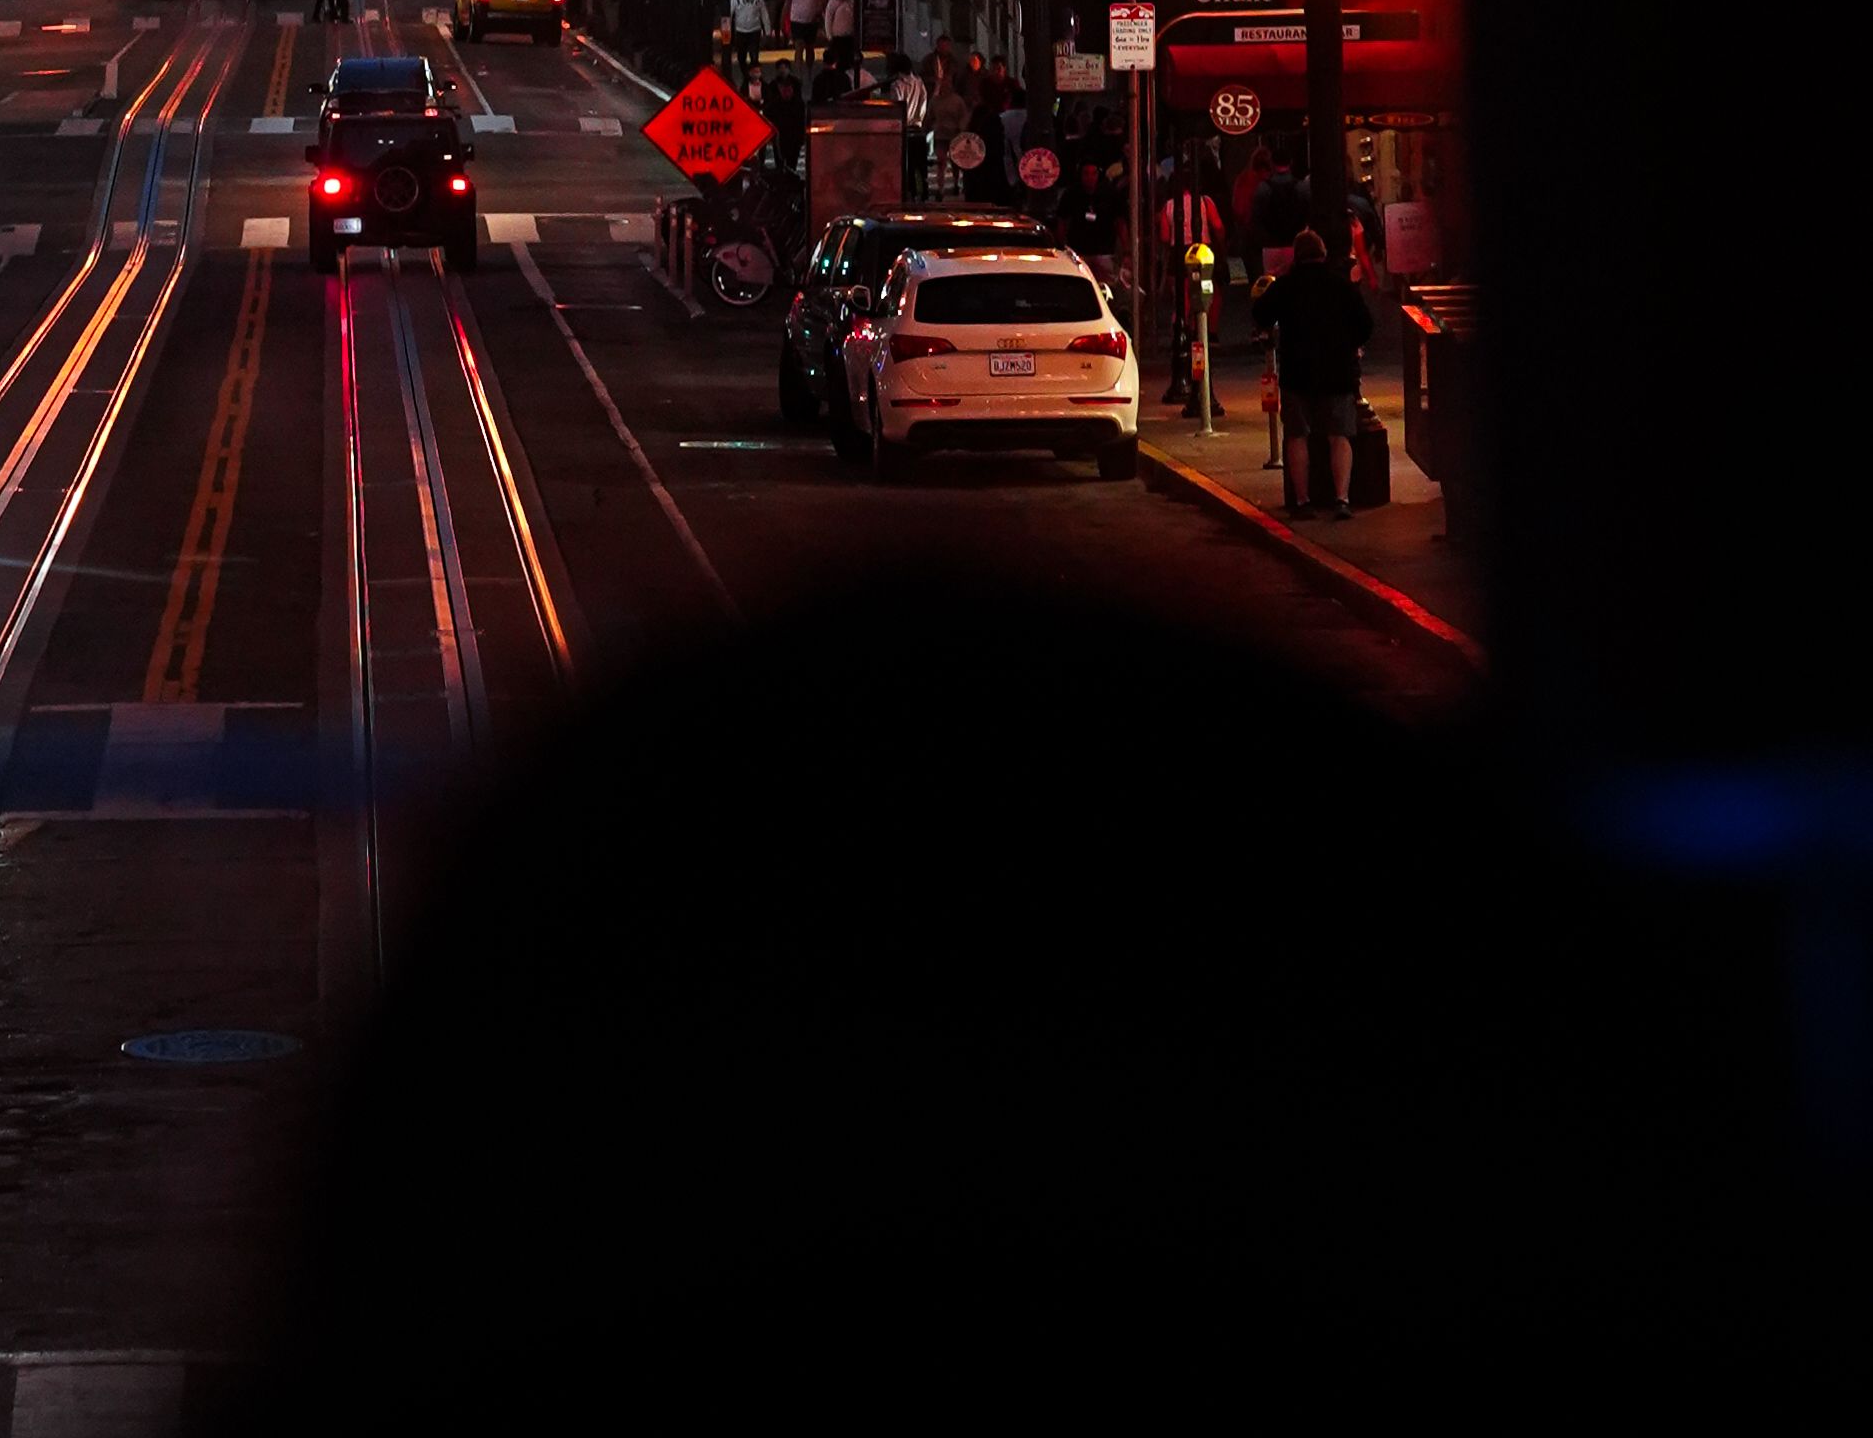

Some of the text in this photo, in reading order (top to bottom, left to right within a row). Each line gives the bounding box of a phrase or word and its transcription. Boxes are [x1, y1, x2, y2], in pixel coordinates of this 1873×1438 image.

[682, 96, 734, 112] ROAD
[1216, 94, 1255, 119] 85
[681, 120, 734, 136] WORK
[1218, 116, 1253, 127] YEARS
[677, 143, 740, 163] AHEAD
